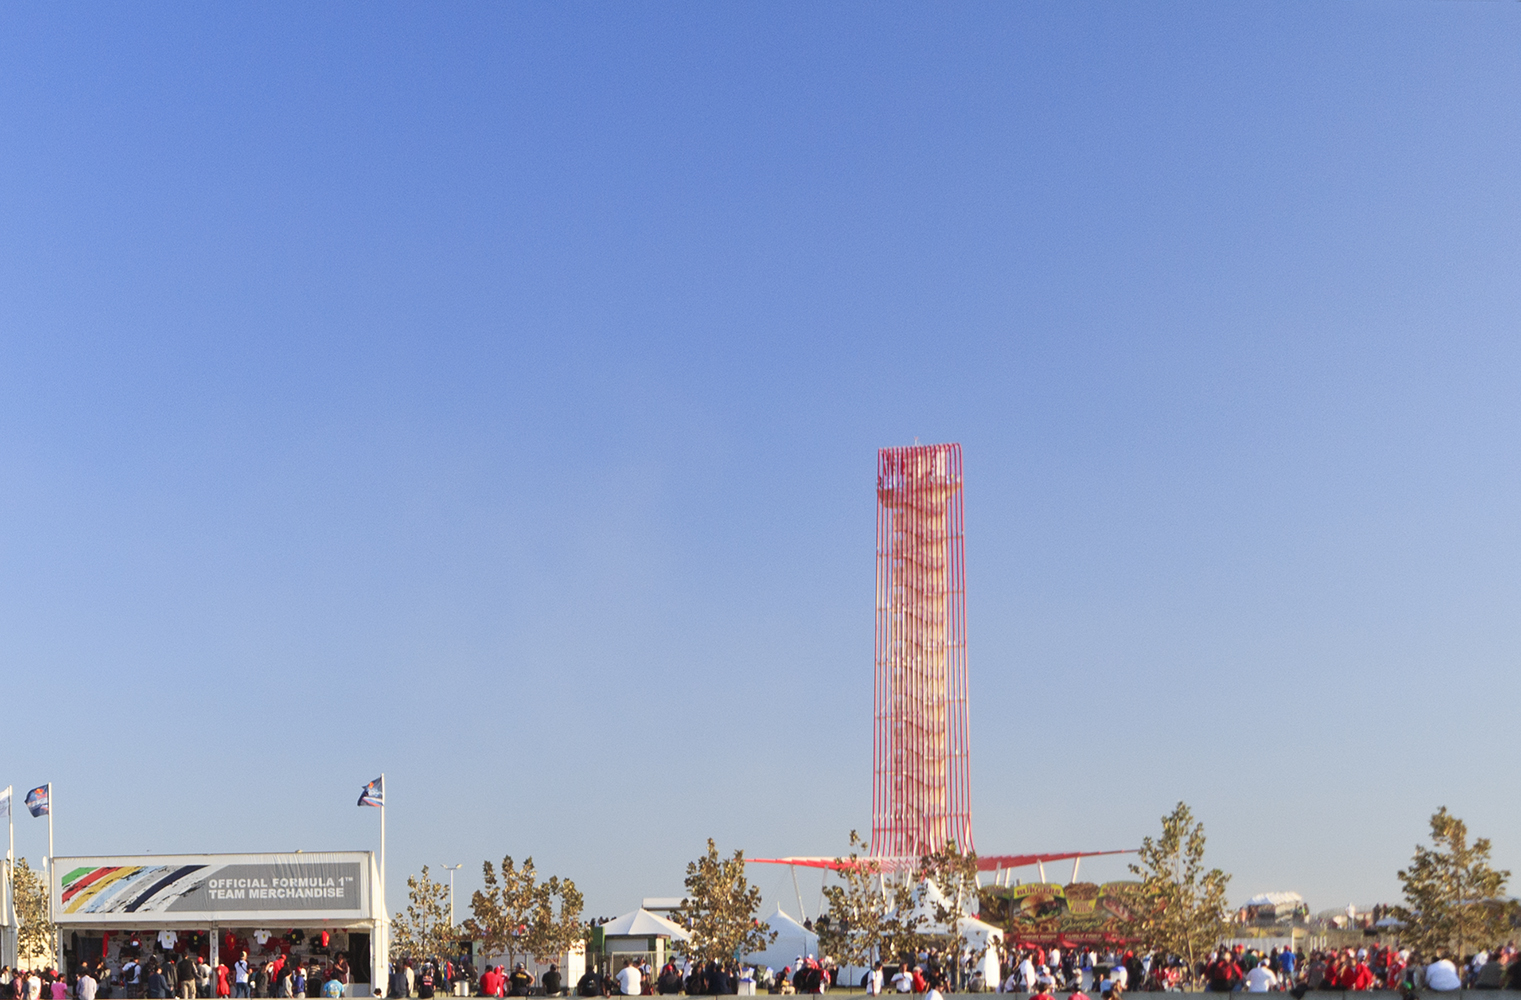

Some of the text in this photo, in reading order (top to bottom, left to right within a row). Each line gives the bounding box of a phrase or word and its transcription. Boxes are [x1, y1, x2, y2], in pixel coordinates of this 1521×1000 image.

[209, 878, 268, 888] OFFICIAL
[272, 877, 335, 888] FORMULA
[209, 887, 344, 899] TEAM MERCHANDISE
